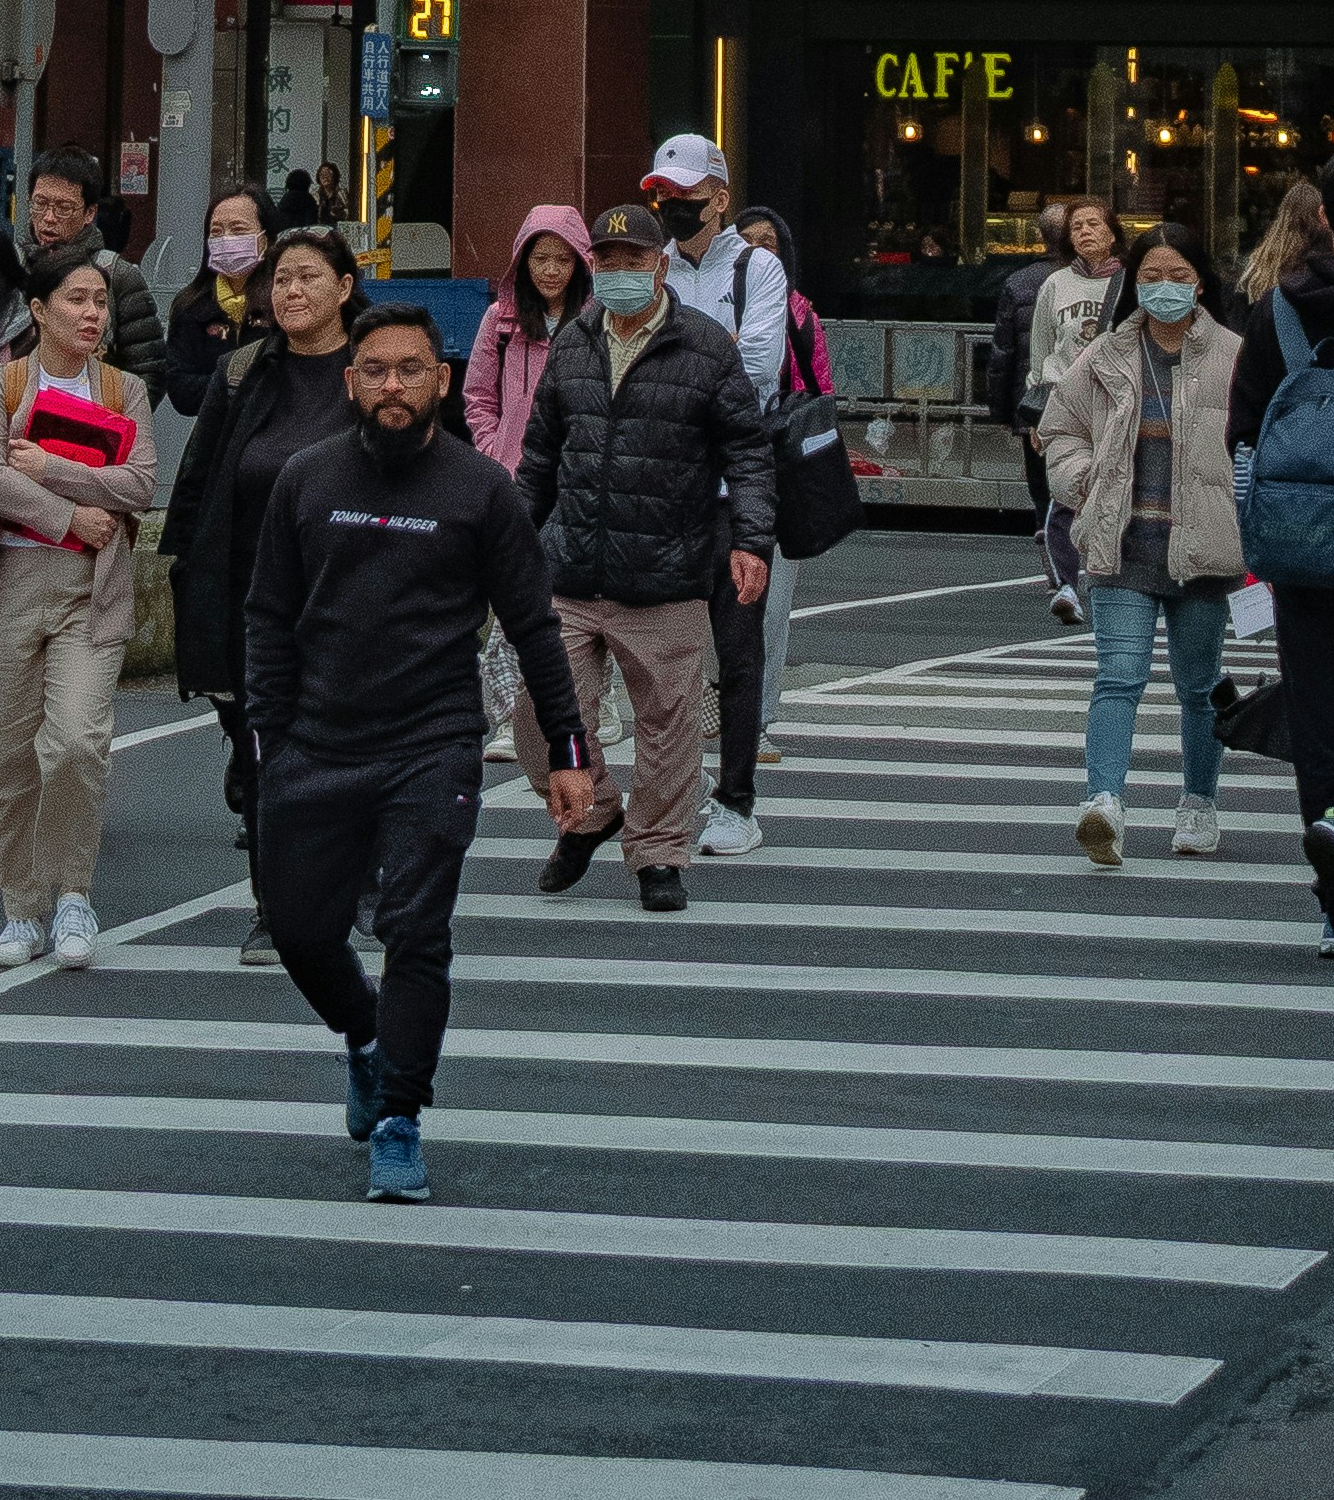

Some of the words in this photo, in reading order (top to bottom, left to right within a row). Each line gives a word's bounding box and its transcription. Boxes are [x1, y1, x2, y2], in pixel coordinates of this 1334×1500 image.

[361, 41, 376, 111] 自行車共用
[375, 41, 391, 111] 人行道行人
[607, 212, 629, 235] NY
[329, 509, 372, 524] TOMMY
[387, 515, 438, 533] HILFIGER
